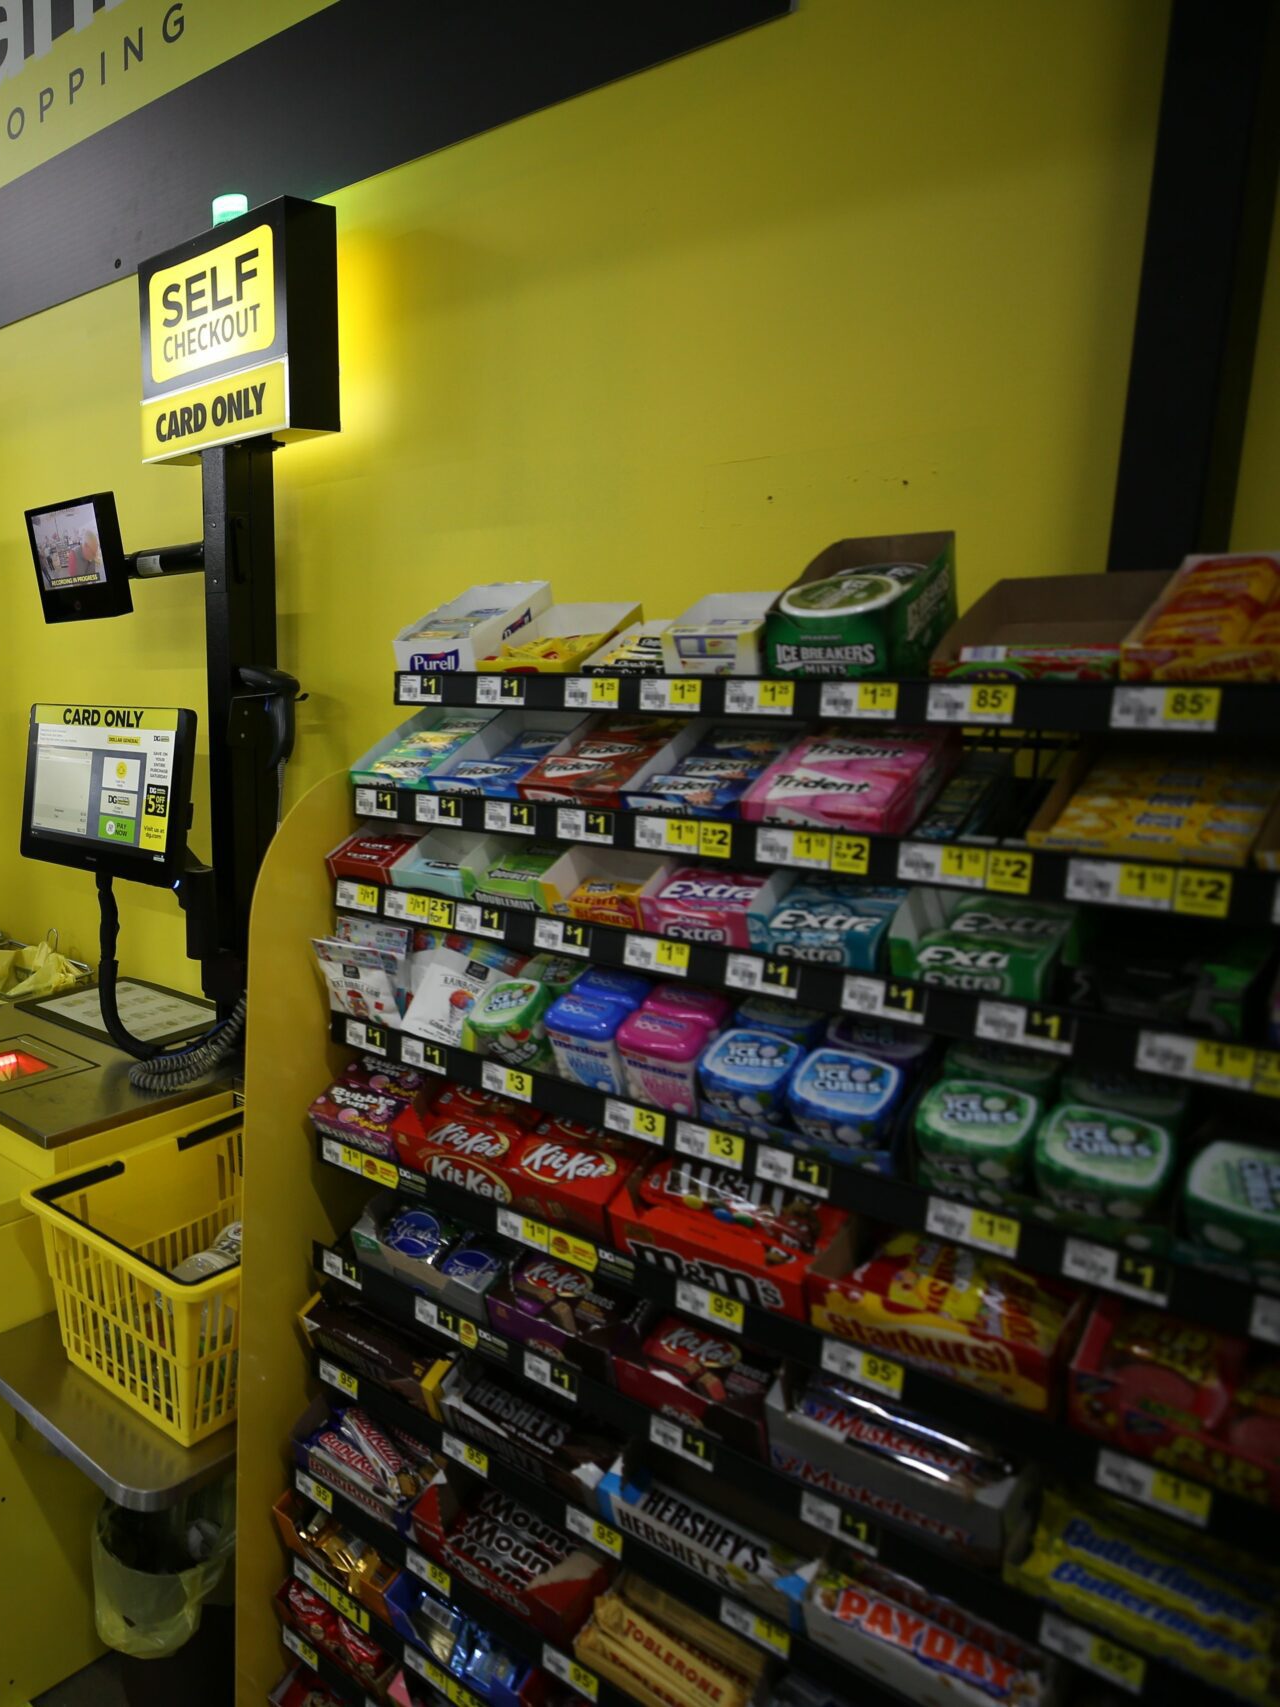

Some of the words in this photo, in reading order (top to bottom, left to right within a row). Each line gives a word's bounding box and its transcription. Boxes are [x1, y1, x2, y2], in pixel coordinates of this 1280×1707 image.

[162, 247, 260, 329] SELF
[163, 303, 261, 364] CHECKOUT
[156, 402, 207, 444] CARD
[211, 382, 267, 428] ONLY
[413, 654, 459, 672] Purell
[775, 644, 799, 663] ICE
[800, 643, 876, 665] BREAKERS
[803, 664, 848, 675] MINTS
[63, 708, 101, 725] CARD
[104, 710, 144, 728] ONLY
[808, 743, 906, 759] Trident
[546, 760, 616, 773] Trident
[650, 778, 731, 792] Trident
[773, 774, 871, 794] Trident
[377, 791, 392, 810] $1
[441, 799, 456, 817] $1
[512, 804, 529, 826] $1
[587, 812, 606, 834] $1
[116, 829, 128, 837] NOW
[359, 841, 392, 850] CLOVE
[658, 880, 760, 900] Extra
[483, 910, 499, 929] $1
[770, 909, 882, 930] Extra
[566, 924, 583, 945] $1
[667, 924, 725, 943] Extra
[776, 944, 844, 962] Extra
[766, 963, 790, 986] $1
[923, 972, 1002, 992] Extra
[889, 984, 915, 1011] $1
[1030, 1010, 1062, 1040] $1
[723, 1053, 787, 1069] CUBES
[729, 1045, 758, 1058] ICE
[627, 1058, 688, 1081] mentos
[818, 1068, 851, 1082] ICE
[509, 1073, 525, 1091] $3
[813, 1078, 882, 1095] CUBES
[945, 1099, 982, 1112] ICE
[638, 1113, 657, 1132] $3
[941, 1109, 1020, 1124] CUBES
[1067, 1125, 1109, 1142] ICE
[714, 1133, 734, 1156] $3
[1066, 1138, 1153, 1158] CUBES
[827, 1311, 1015, 1374] Starburst
[479, 1490, 578, 1556] Moun
[640, 1489, 767, 1574] HERSHEY'S
[464, 1514, 554, 1577] Moun
[618, 1508, 731, 1589] HERSHEY'S
[835, 1587, 1018, 1689] PAYDAY
[622, 1618, 723, 1702] TOBLERONE
